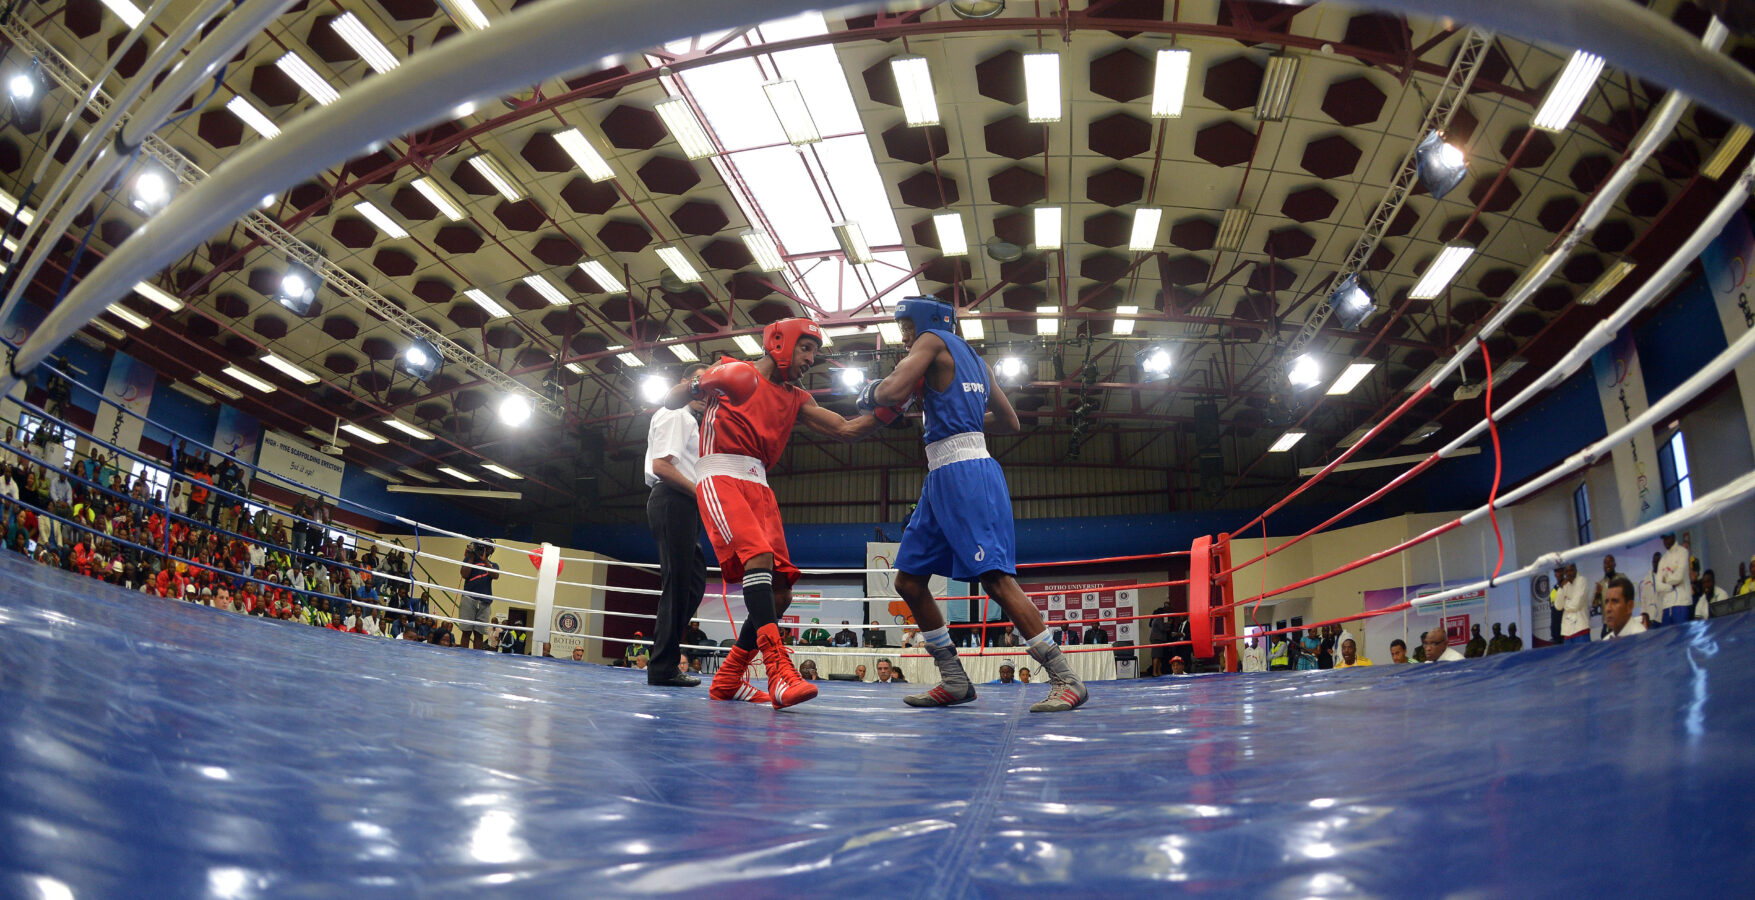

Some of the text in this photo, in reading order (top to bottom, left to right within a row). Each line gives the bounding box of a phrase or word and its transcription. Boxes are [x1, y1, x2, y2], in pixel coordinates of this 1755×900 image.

[264, 437, 277, 448] HIGH
[279, 442, 291, 453] RISE
[290, 447, 320, 465] SCAFFOLDING
[320, 458, 343, 473] ERECTORS
[553, 637, 581, 646] BOTHO
